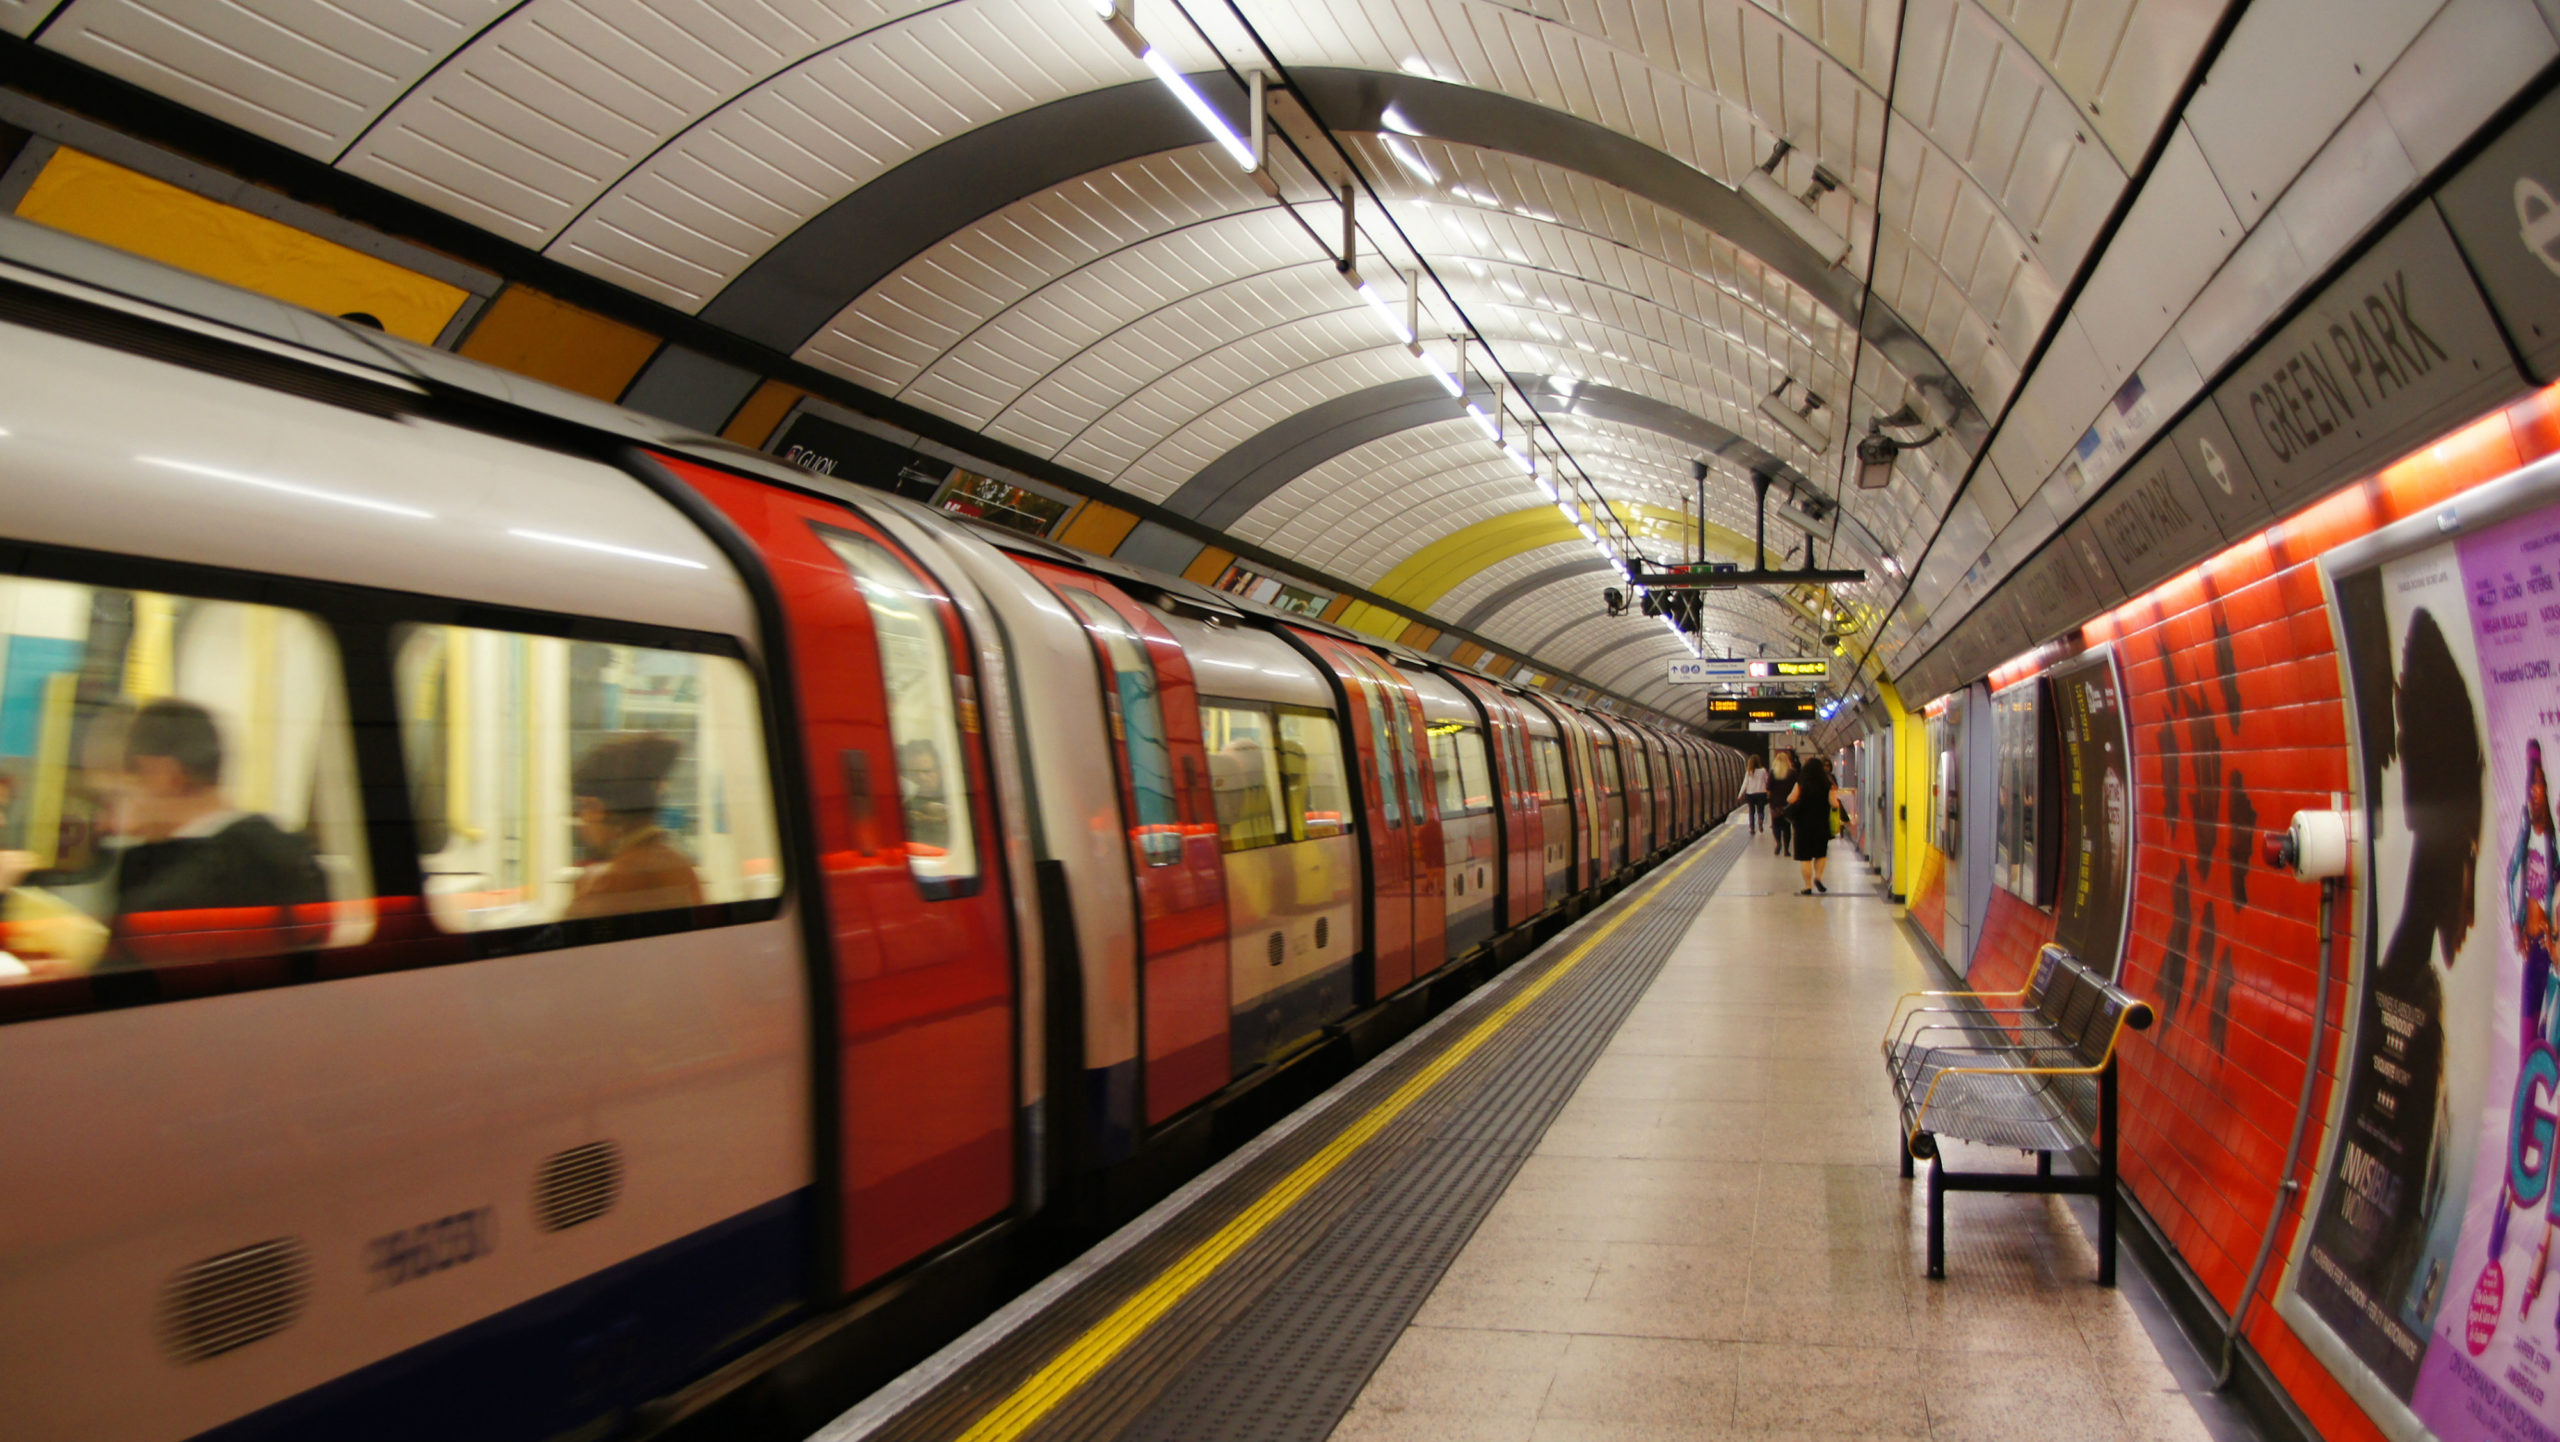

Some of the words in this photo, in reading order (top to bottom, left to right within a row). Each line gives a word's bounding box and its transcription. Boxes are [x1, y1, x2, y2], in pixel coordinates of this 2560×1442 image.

[2249, 340, 2355, 463] GREEN
[2328, 269, 2449, 409] PARK
[2103, 494, 2159, 566] GREEN
[2136, 467, 2193, 540] PARK
[1777, 663, 1798, 675] Way
[1798, 663, 1815, 674] out
[2340, 1140, 2402, 1218] INVISIBLE
[2449, 1352, 2463, 1377] ON
[2462, 1361, 2497, 1406] DEMAND
[2496, 1393, 2517, 1424] AND
